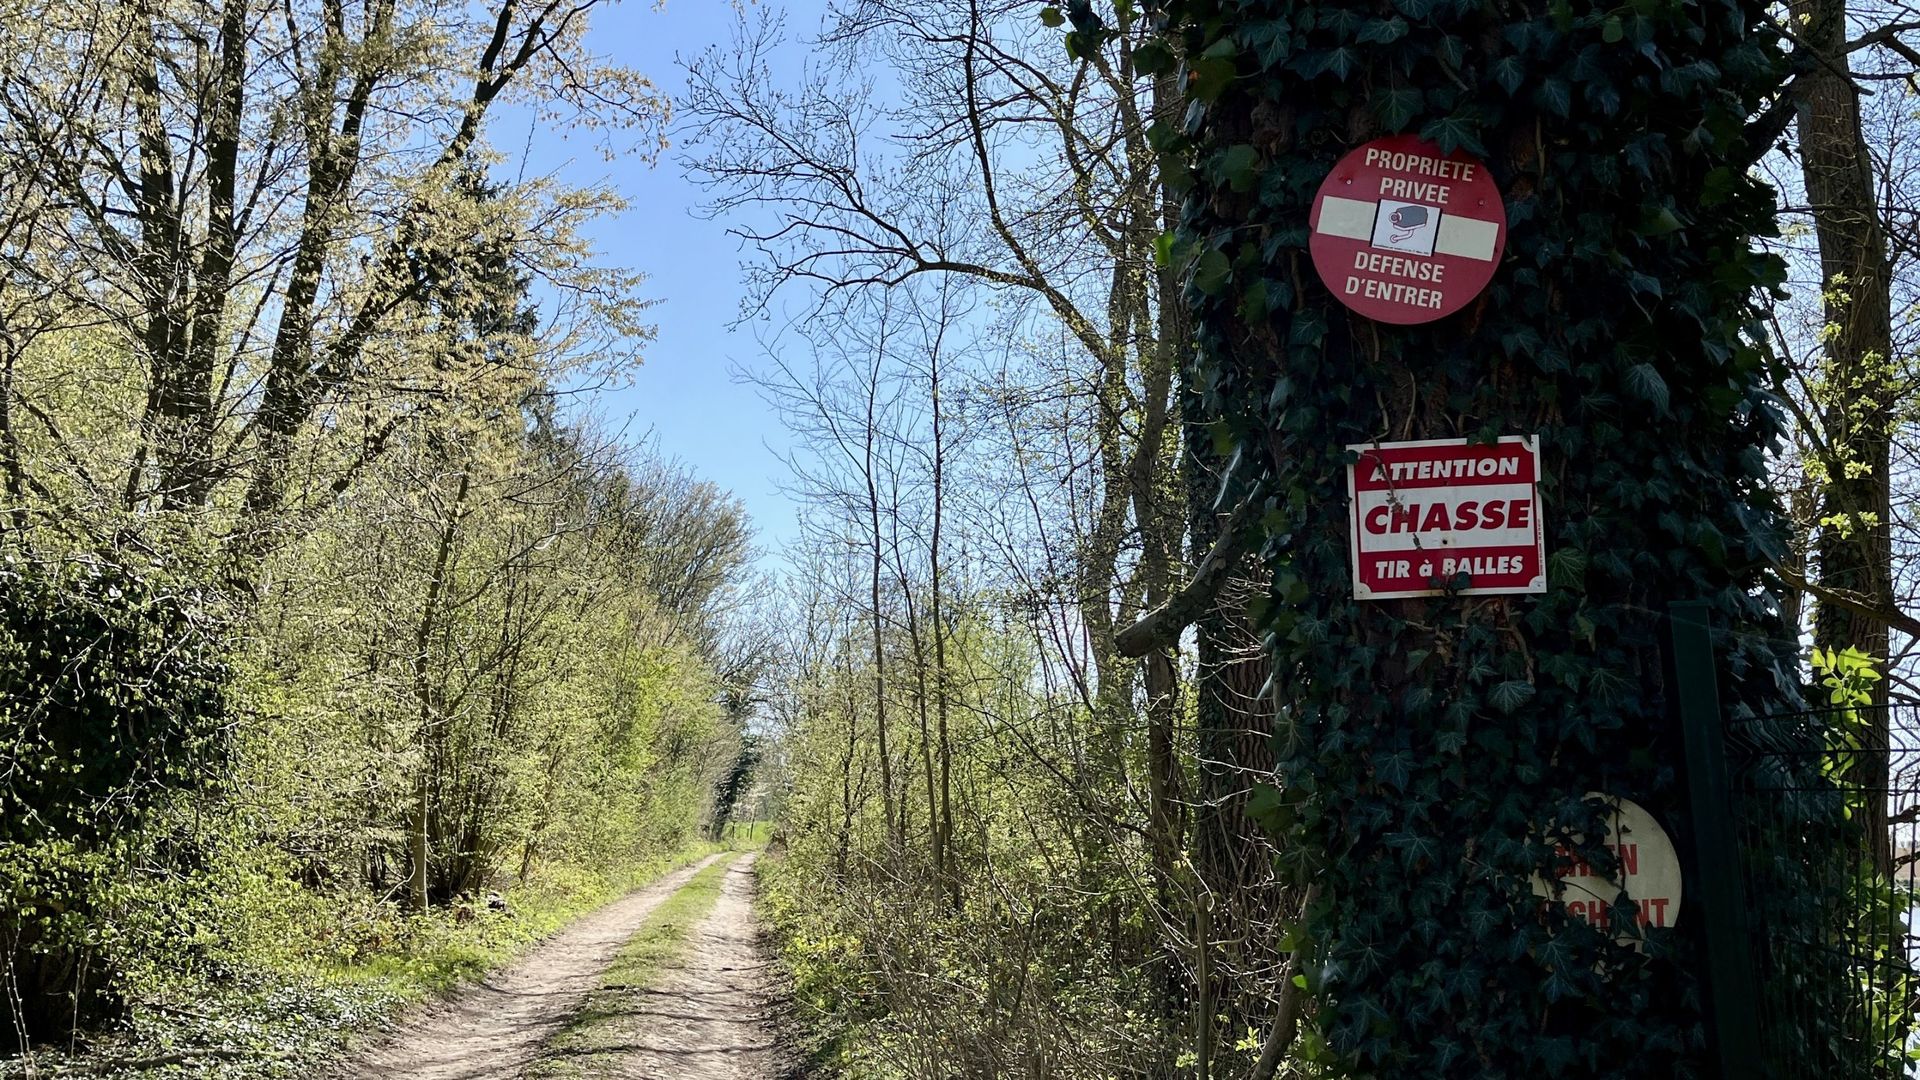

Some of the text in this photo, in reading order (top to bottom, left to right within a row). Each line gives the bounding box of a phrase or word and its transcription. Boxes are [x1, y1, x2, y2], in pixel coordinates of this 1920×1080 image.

[1365, 148, 1475, 182] PROPRIETE
[1379, 177, 1450, 204] PRIVEE
[1354, 251, 1445, 283] DEFENSE
[1345, 276, 1443, 309] D'ENTRER
[1369, 457, 1519, 482] ATTENTION
[1365, 499, 1531, 535] CHASSE
[1376, 556, 1524, 579] TIR à BALLES
